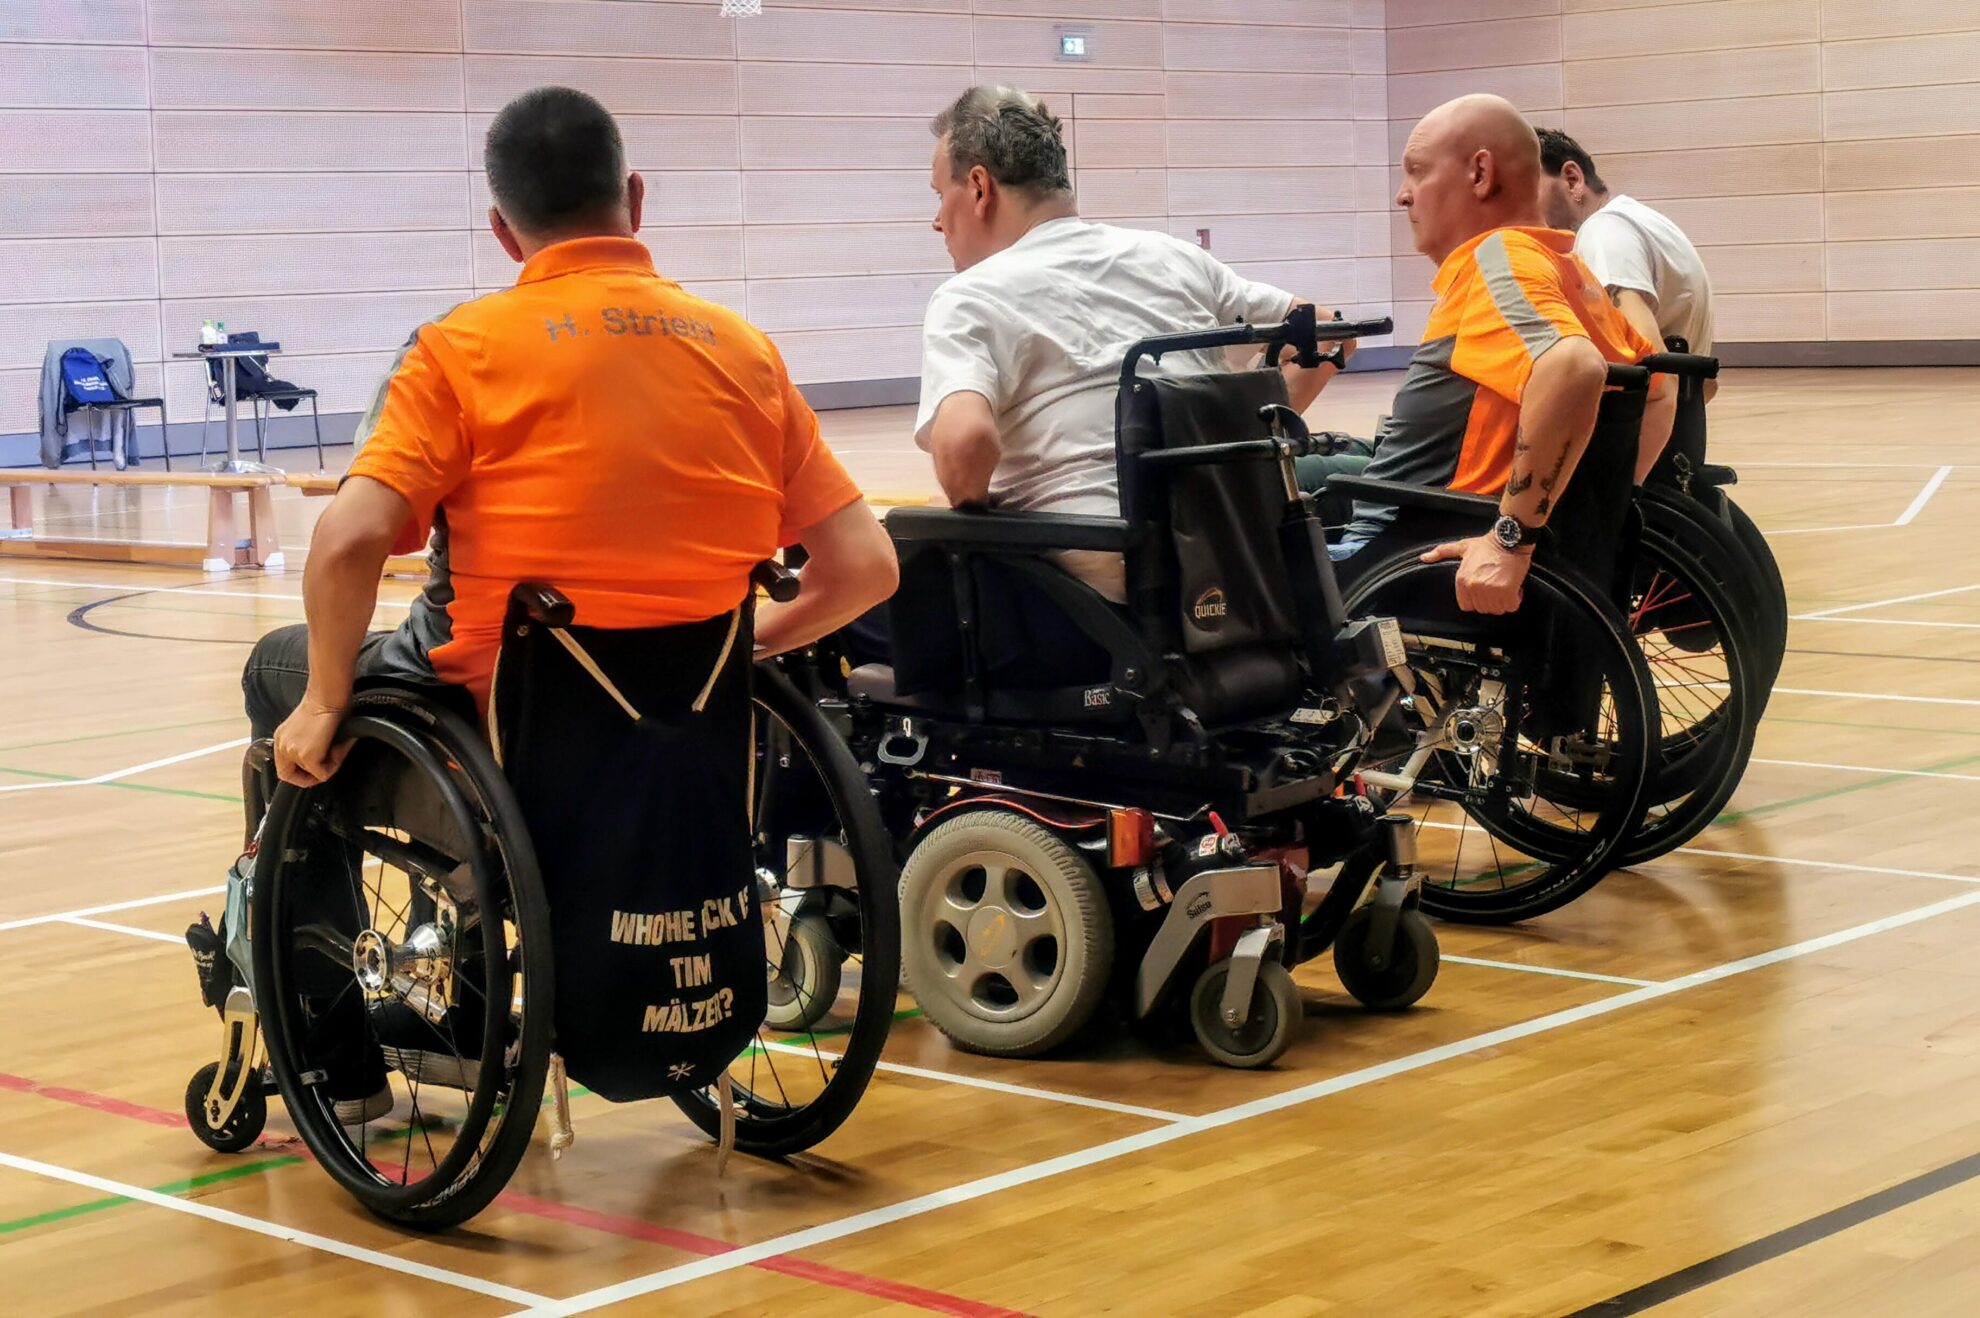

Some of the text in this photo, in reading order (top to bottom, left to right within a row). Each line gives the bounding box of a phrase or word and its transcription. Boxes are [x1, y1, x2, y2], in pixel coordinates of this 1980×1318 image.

[1194, 603, 1226, 619] QUICKIE
[1084, 689, 1111, 707] Basic
[670, 953, 712, 988] TIM
[641, 987, 734, 1033] MÄLZER?
